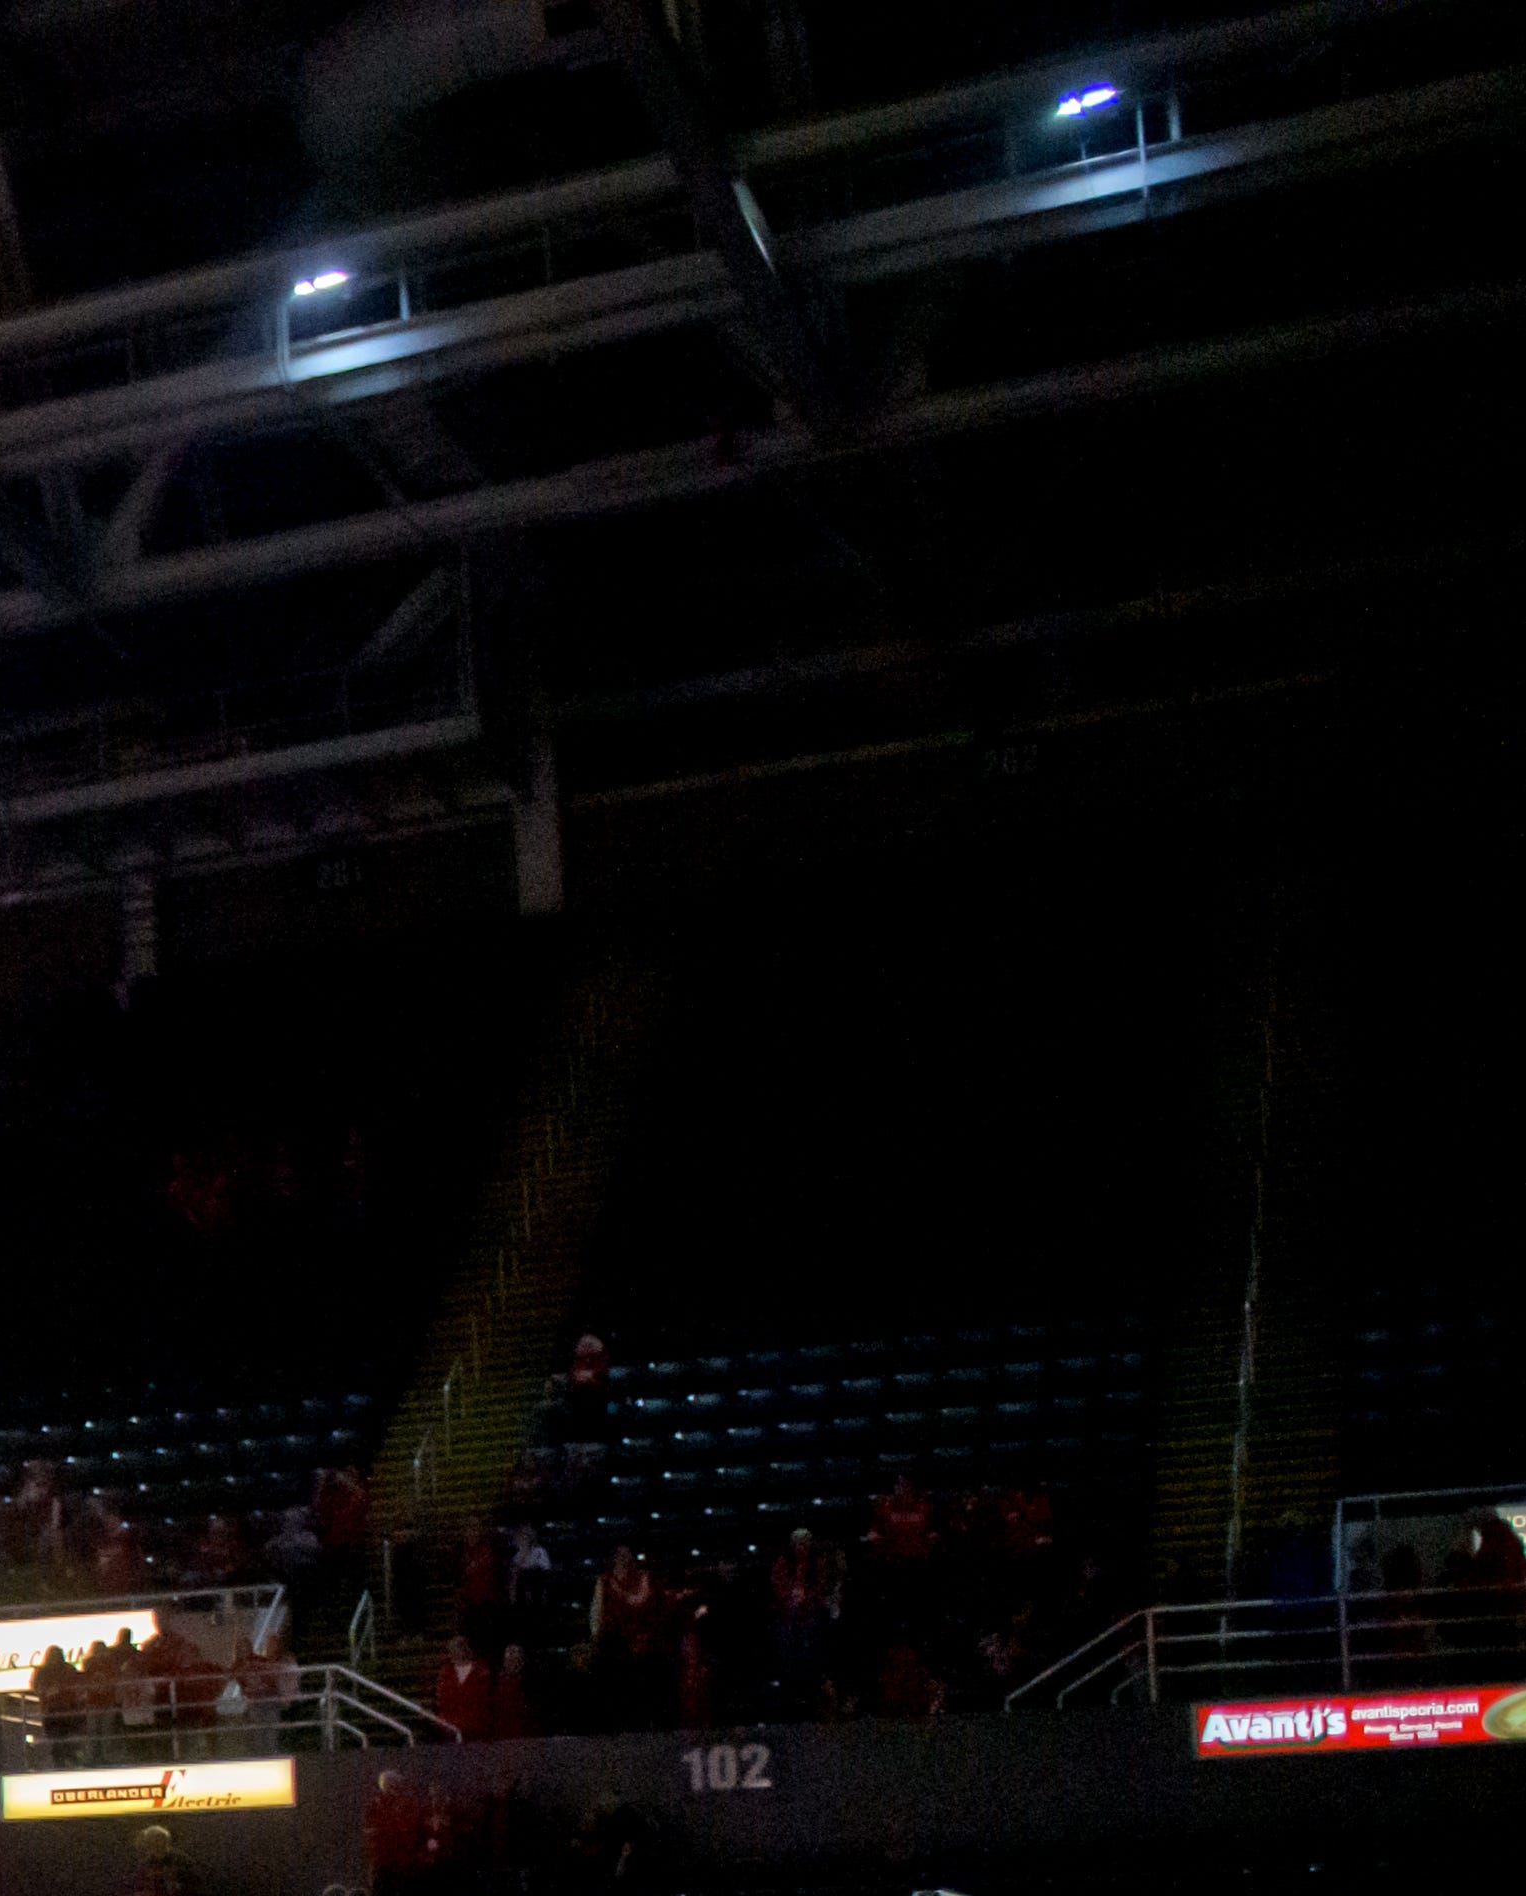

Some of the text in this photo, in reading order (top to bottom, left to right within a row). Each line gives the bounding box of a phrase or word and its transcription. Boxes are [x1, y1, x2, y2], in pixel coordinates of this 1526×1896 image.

[1201, 1700, 1479, 1744] Avanti's avantispeoria.com
[680, 1744, 773, 1793] 102
[51, 1787, 165, 1804] OBERLANDER
